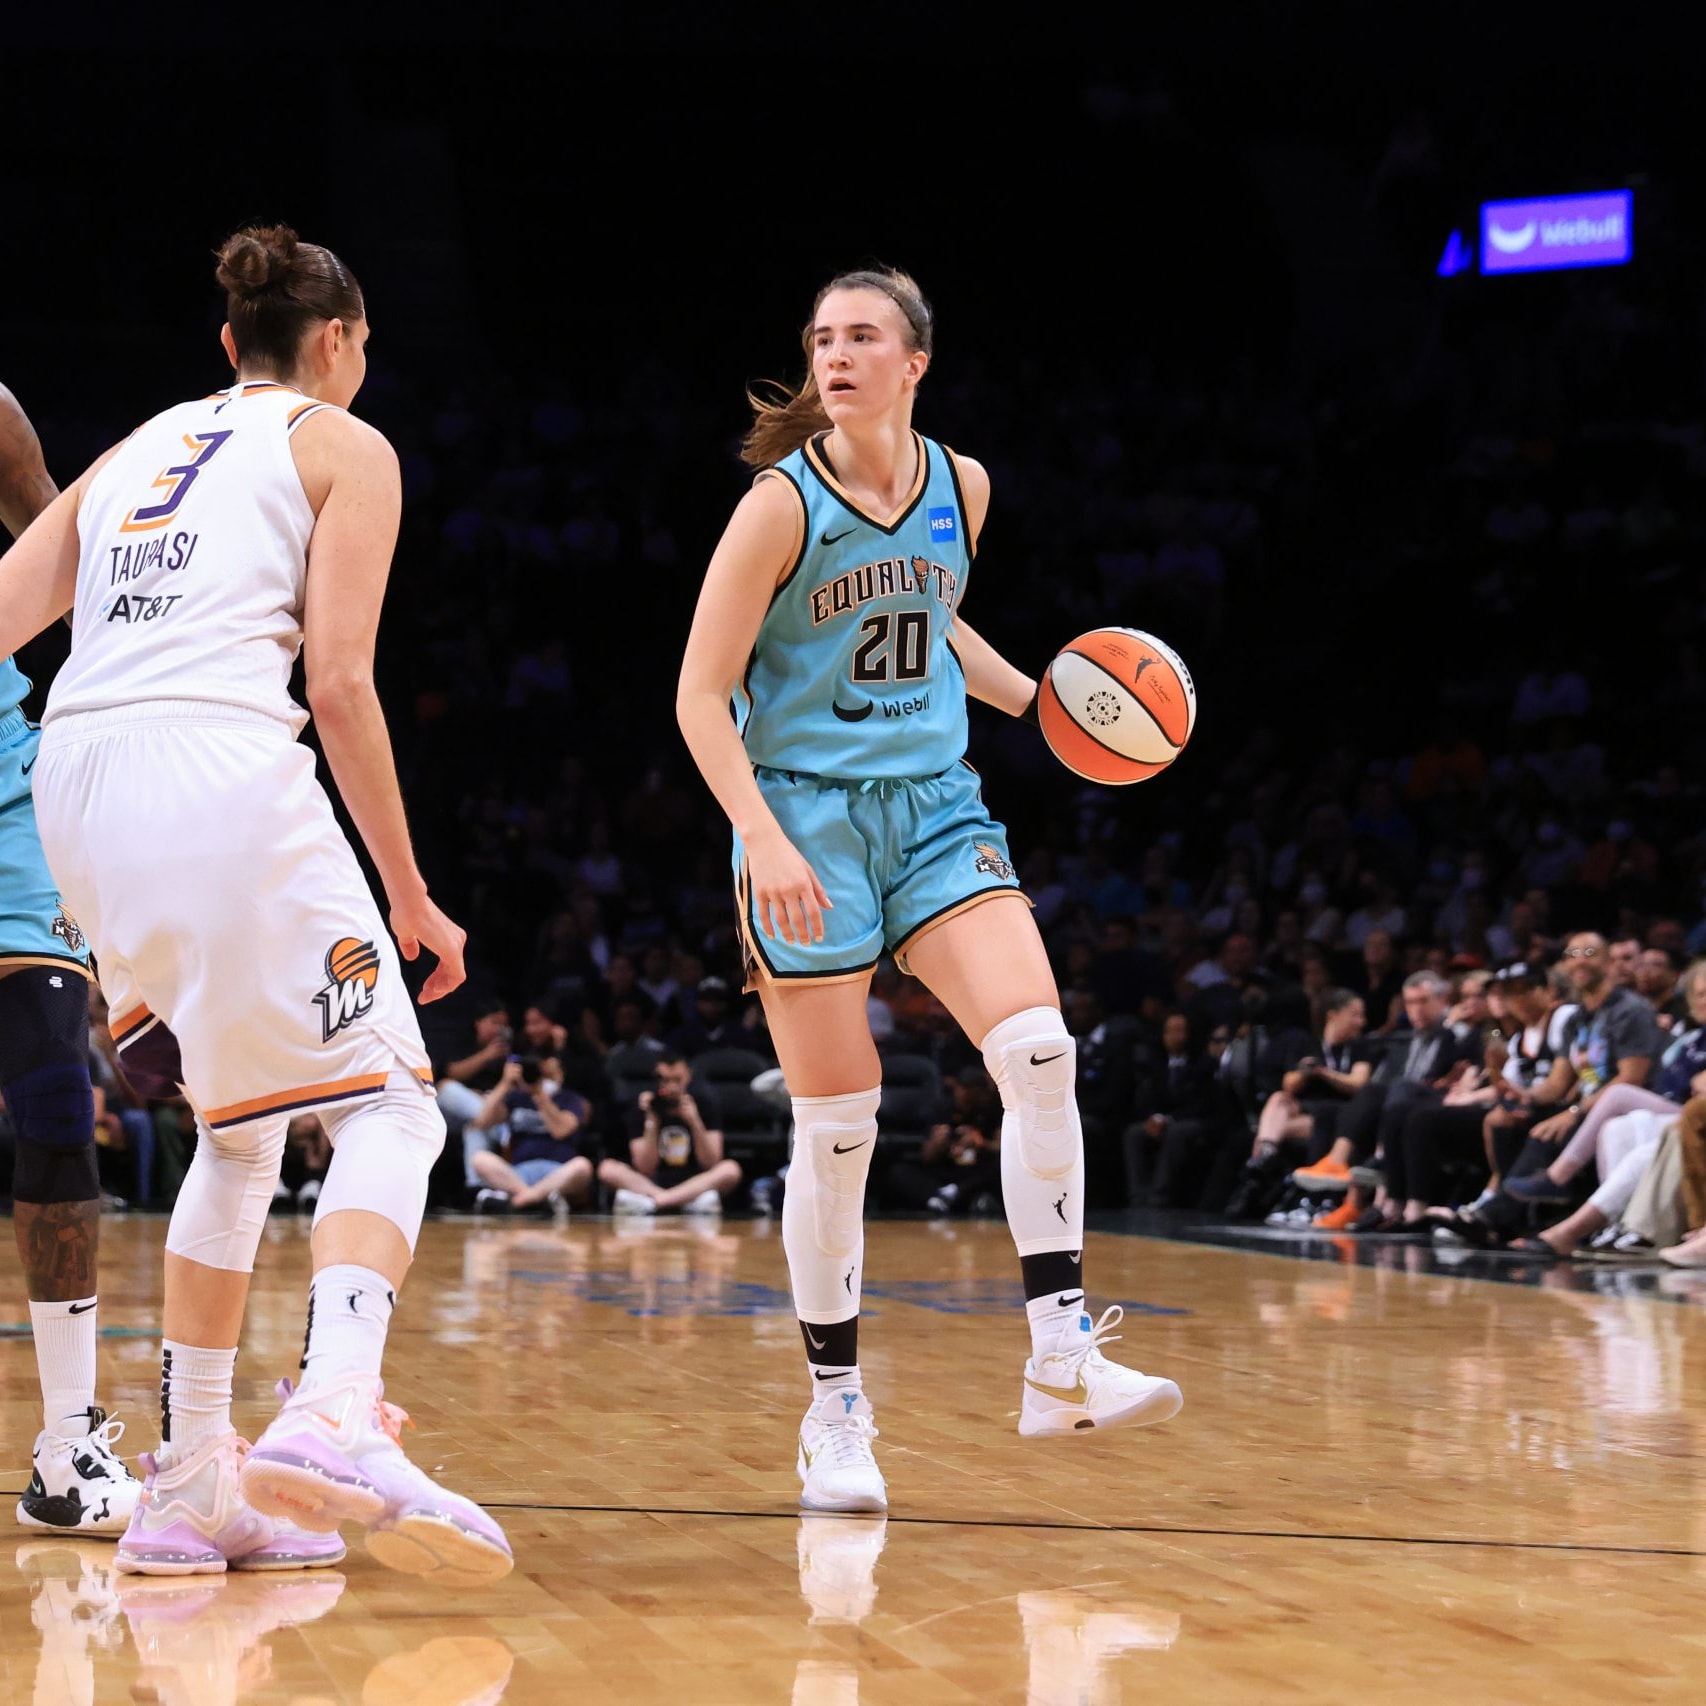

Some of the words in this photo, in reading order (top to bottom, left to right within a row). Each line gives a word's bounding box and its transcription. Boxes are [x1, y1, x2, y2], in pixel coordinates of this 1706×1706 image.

[119, 430, 234, 533] 3
[931, 517, 953, 530] HSS
[107, 594, 183, 623] AT&T
[851, 610, 930, 683] 20
[881, 691, 930, 718] Webll
